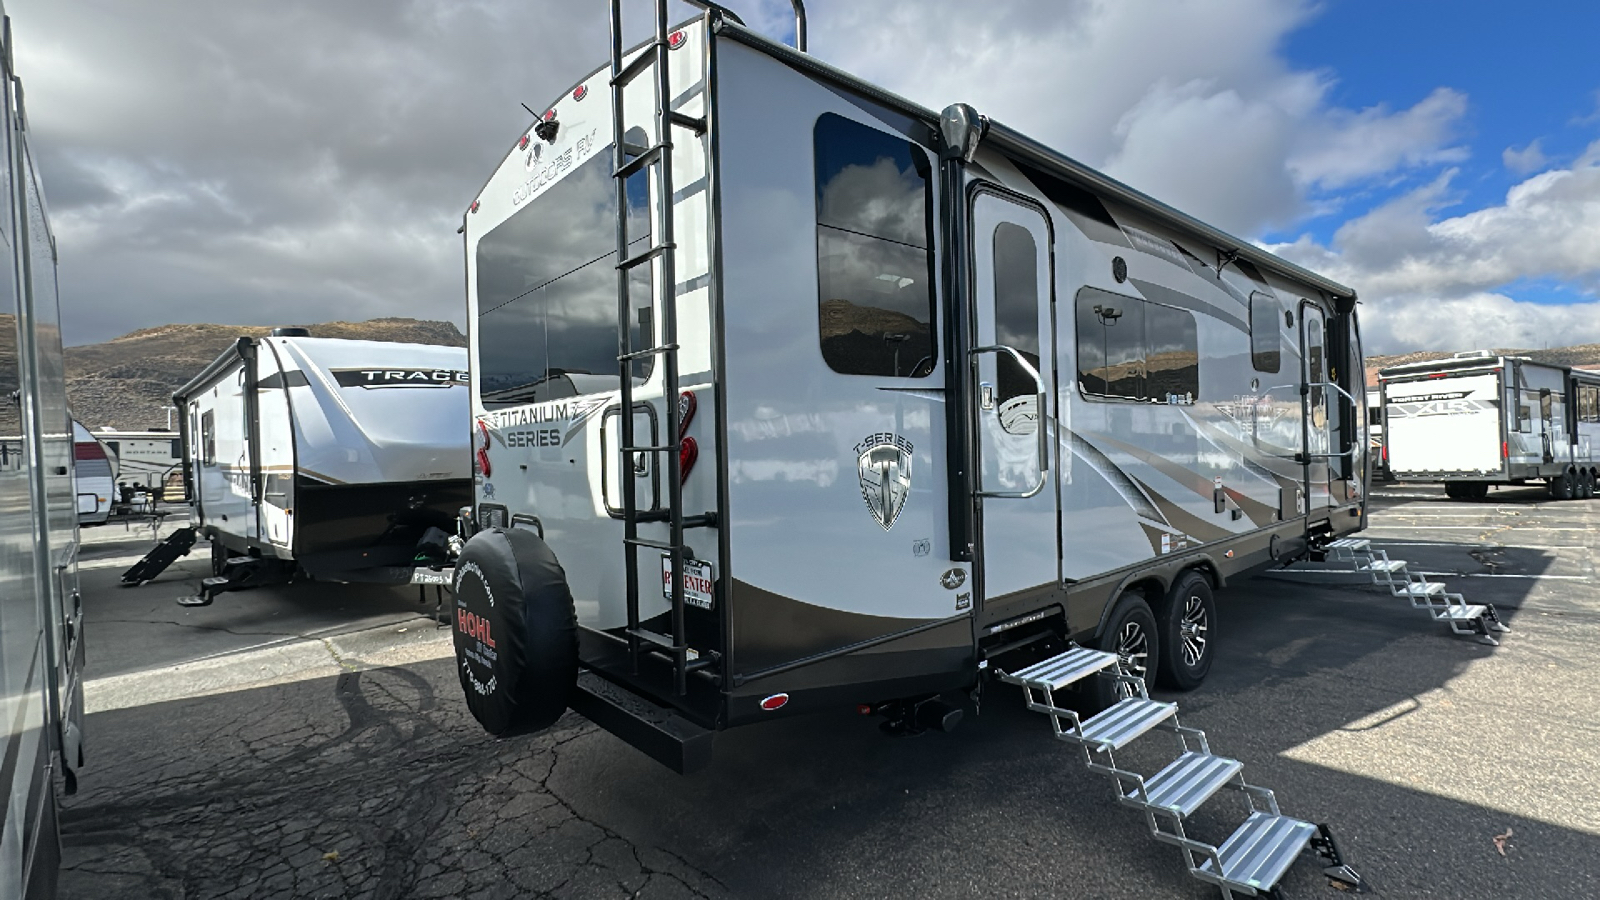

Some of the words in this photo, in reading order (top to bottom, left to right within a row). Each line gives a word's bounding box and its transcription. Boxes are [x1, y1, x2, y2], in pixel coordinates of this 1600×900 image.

[500, 403, 568, 428] TITANIUM
[507, 429, 561, 448] SERIES
[853, 432, 914, 454] T-SERIES
[457, 608, 496, 648] HOHL
